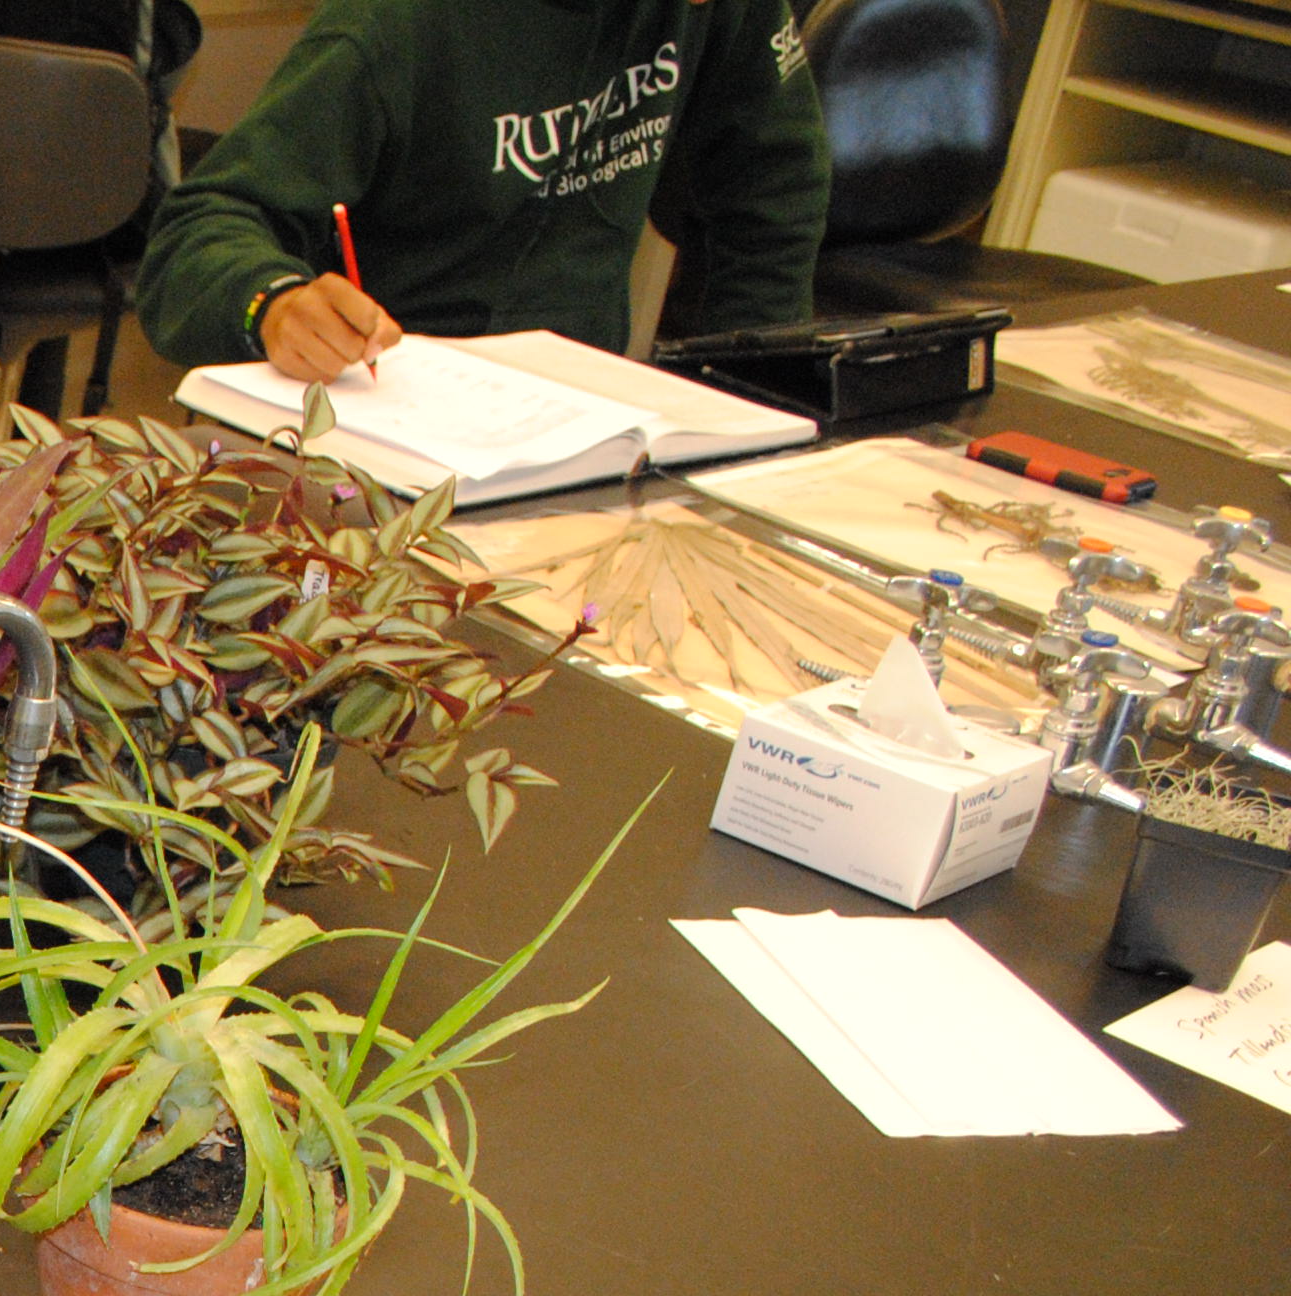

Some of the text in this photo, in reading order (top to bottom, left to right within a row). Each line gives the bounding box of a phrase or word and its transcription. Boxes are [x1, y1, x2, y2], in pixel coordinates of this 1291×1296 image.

[556, 143, 648, 196] Bioogical
[748, 736, 795, 765] VWR
[742, 760, 759, 773] VWR
[762, 767, 780, 784] Light
[783, 776, 800, 792] Duty
[827, 793, 853, 811] Wipers
